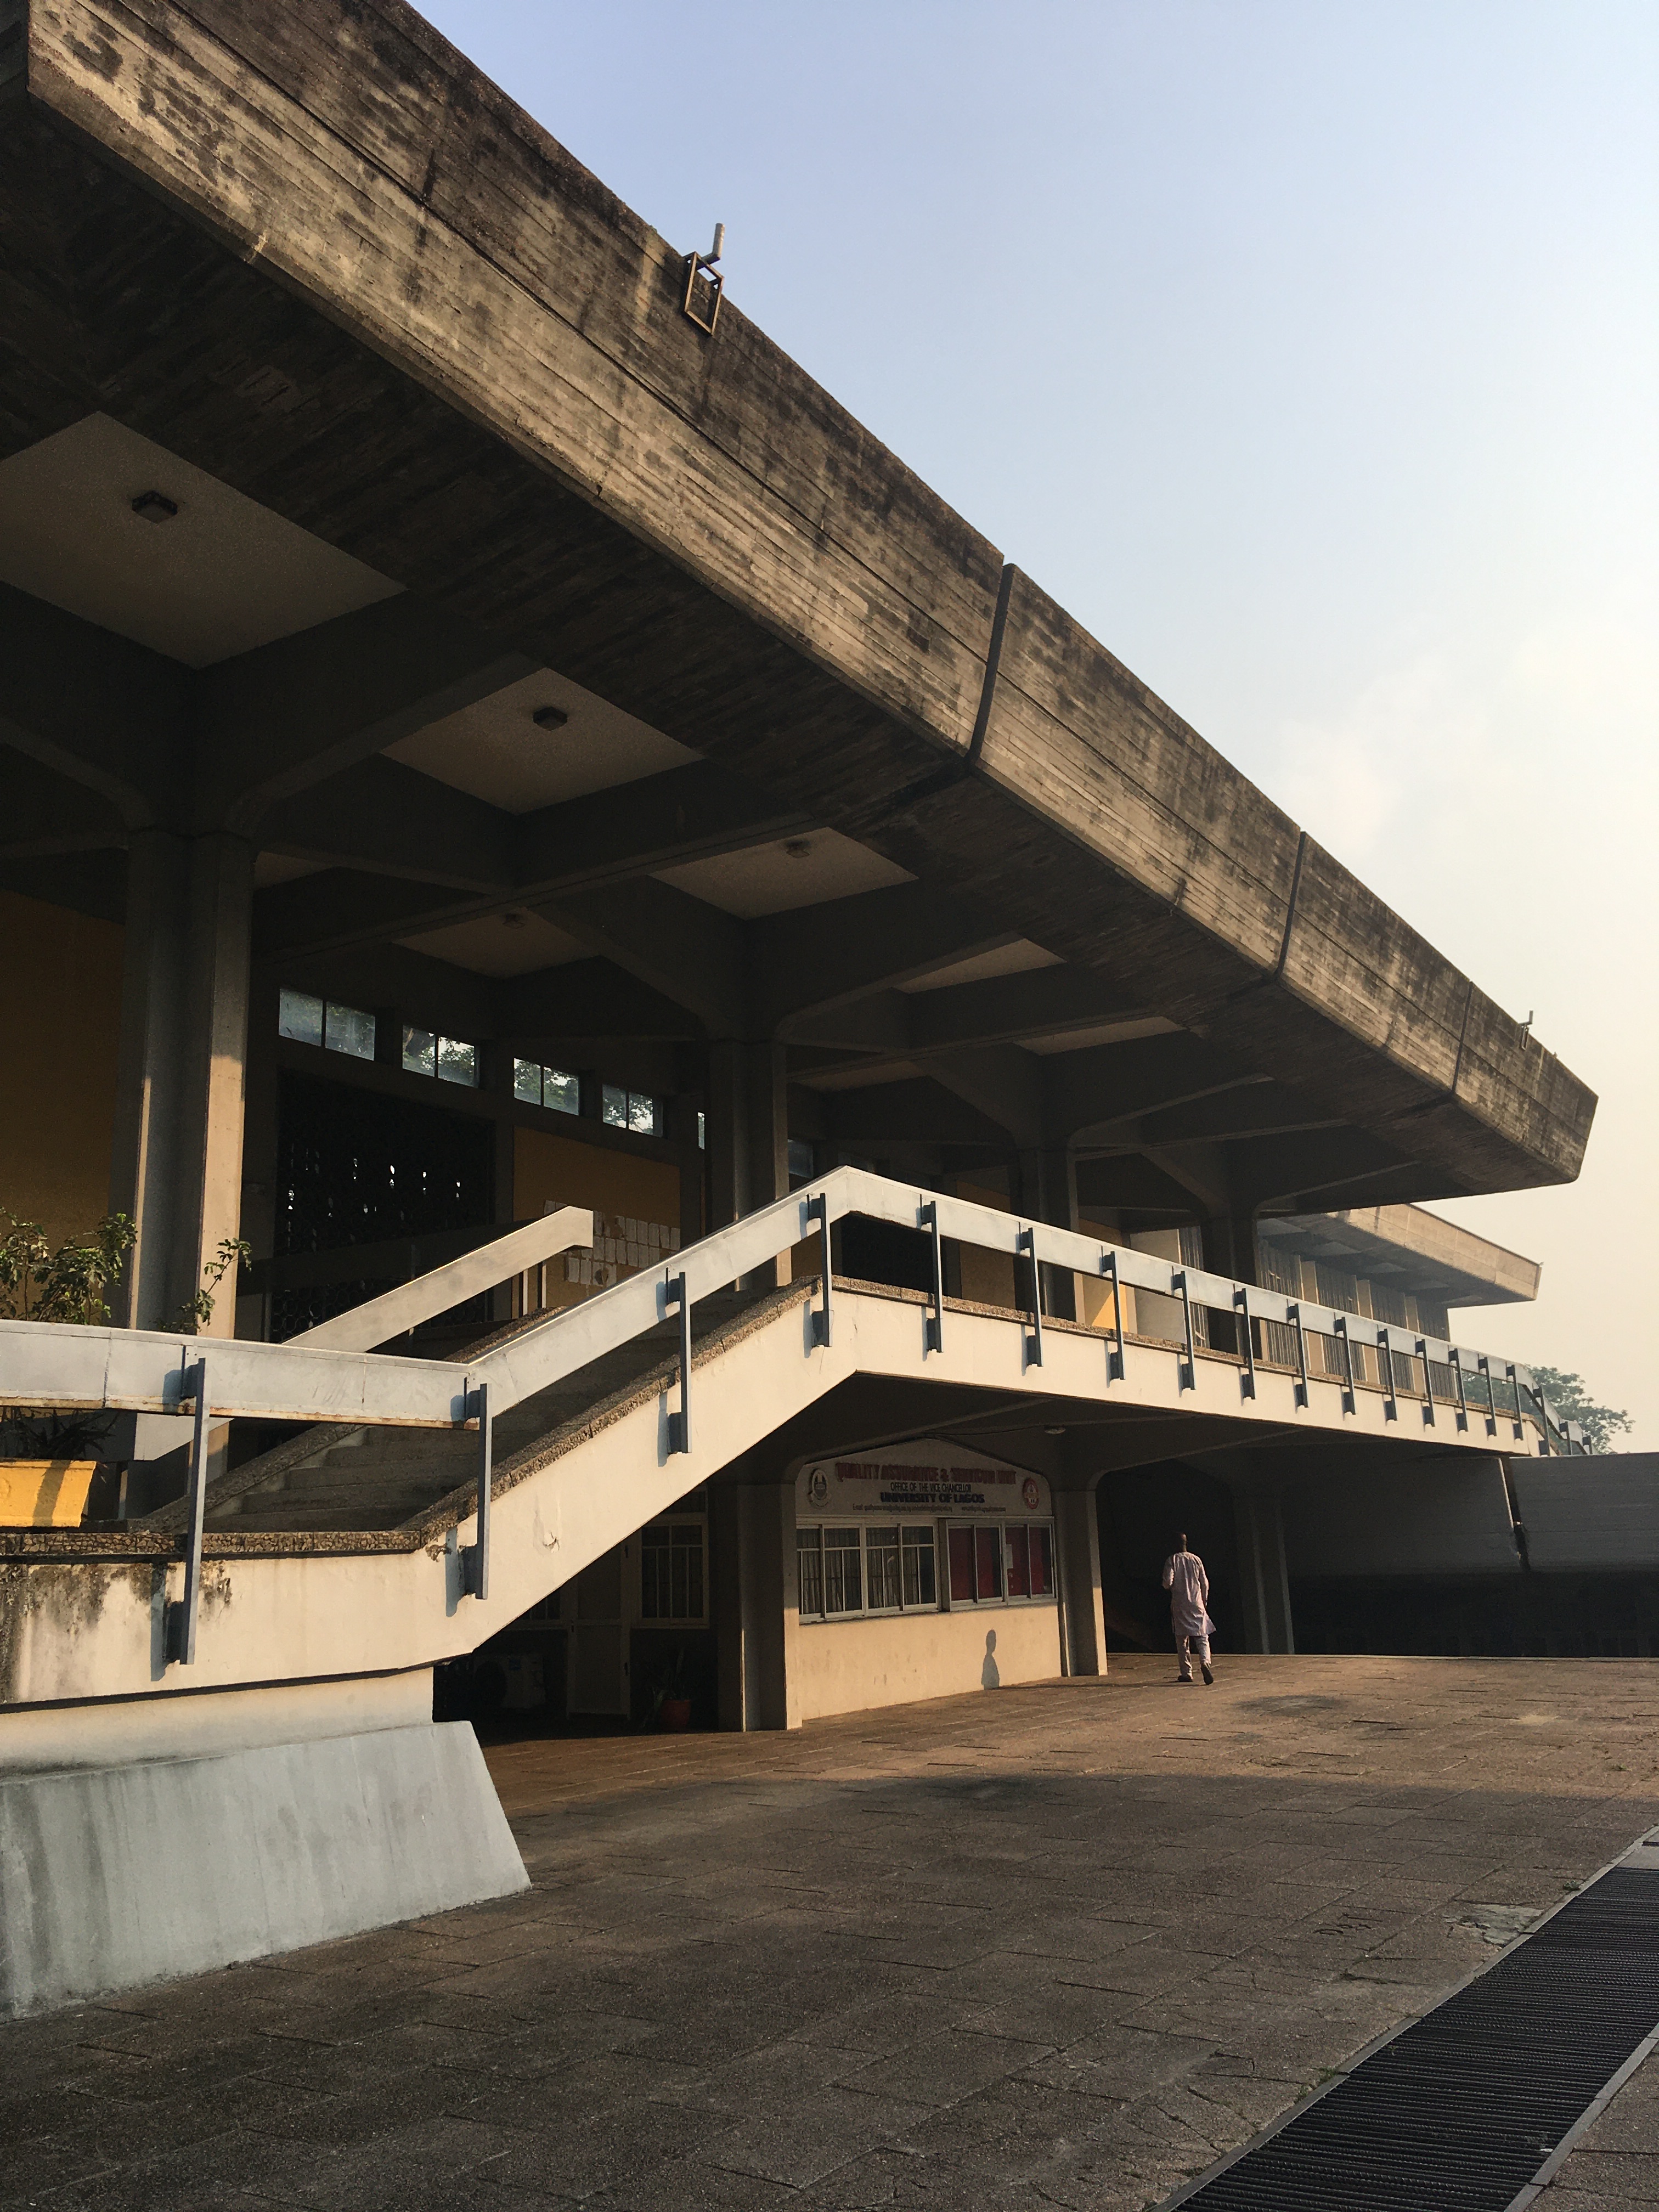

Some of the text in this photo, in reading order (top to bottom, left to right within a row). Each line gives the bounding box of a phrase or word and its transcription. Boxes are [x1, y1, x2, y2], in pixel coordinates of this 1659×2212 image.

[835, 1463, 879, 1482] QUALITY
[940, 1469, 949, 1482] &
[890, 1482, 972, 1493] OFFICE OF THE VICE CHANCELLOR
[881, 1492, 985, 1503] UNIVERSITY OF LAGOS
